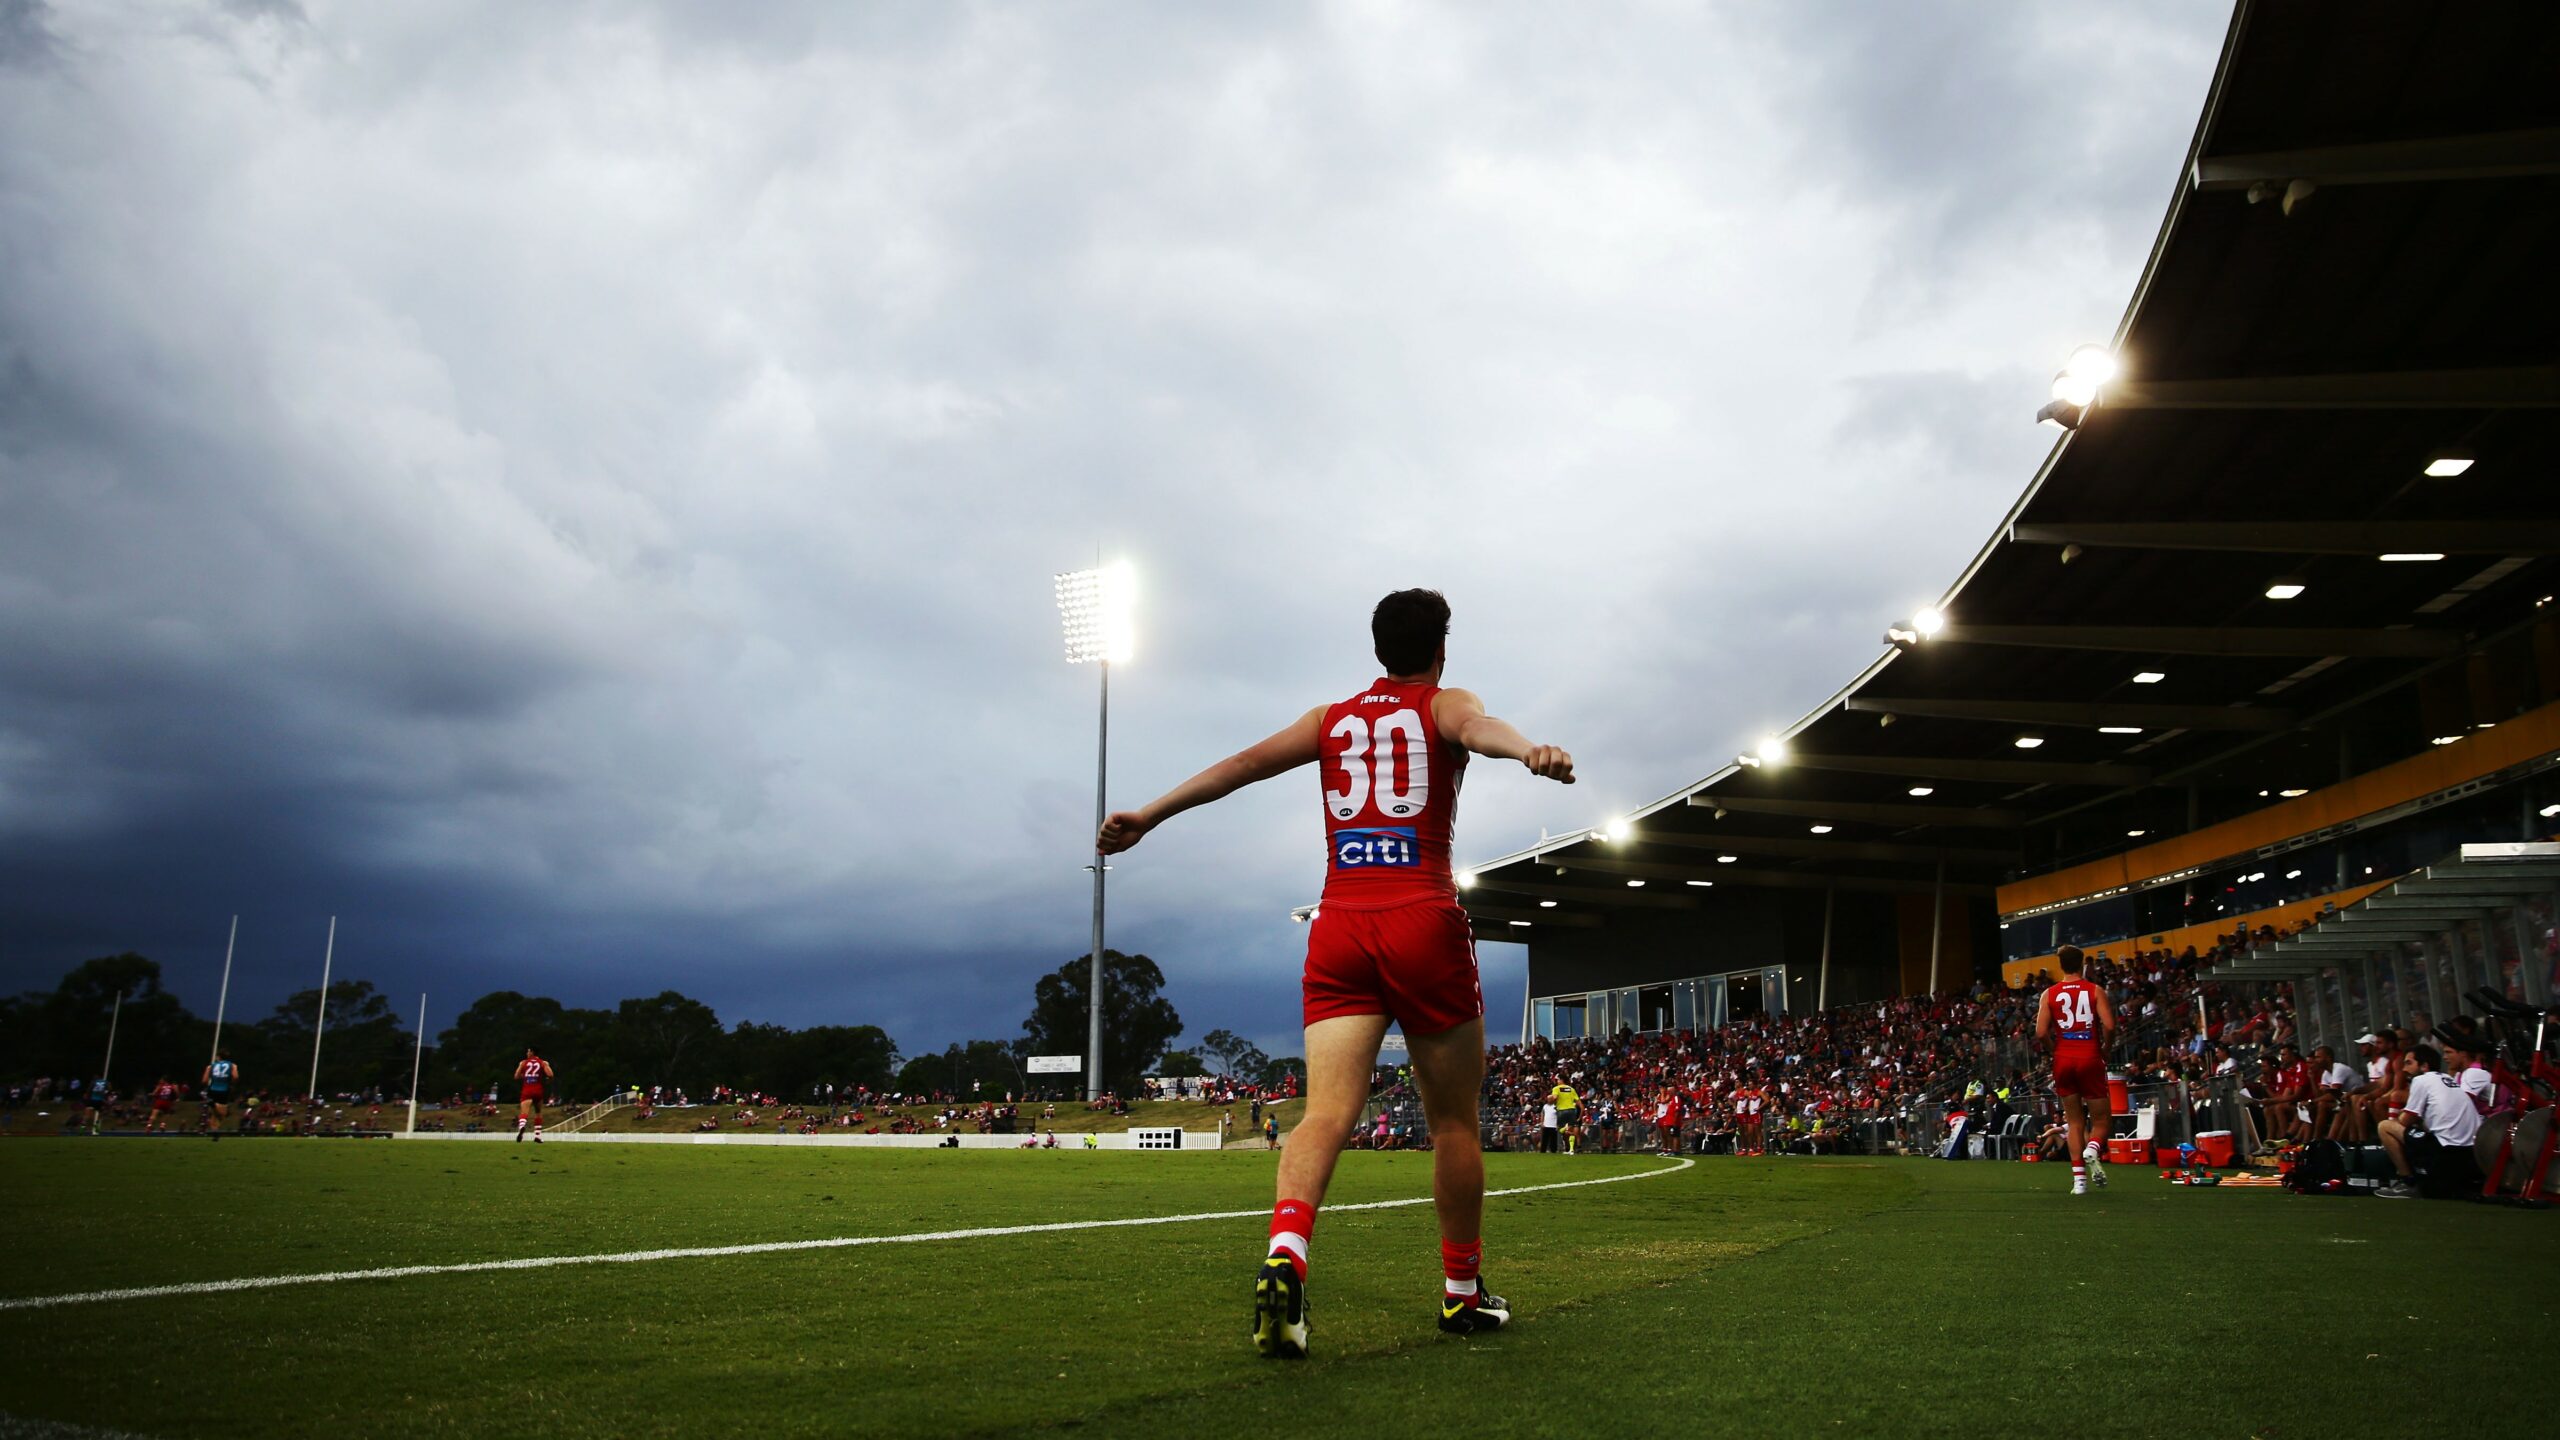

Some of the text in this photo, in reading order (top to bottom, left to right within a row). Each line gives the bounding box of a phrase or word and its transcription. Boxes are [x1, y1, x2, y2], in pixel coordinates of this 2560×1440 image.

[1326, 708, 1429, 821] 30
[1339, 836, 1410, 864] citi
[2056, 990, 2094, 1029] 34
[213, 1063, 230, 1077] 42
[525, 1062, 541, 1077] 22
